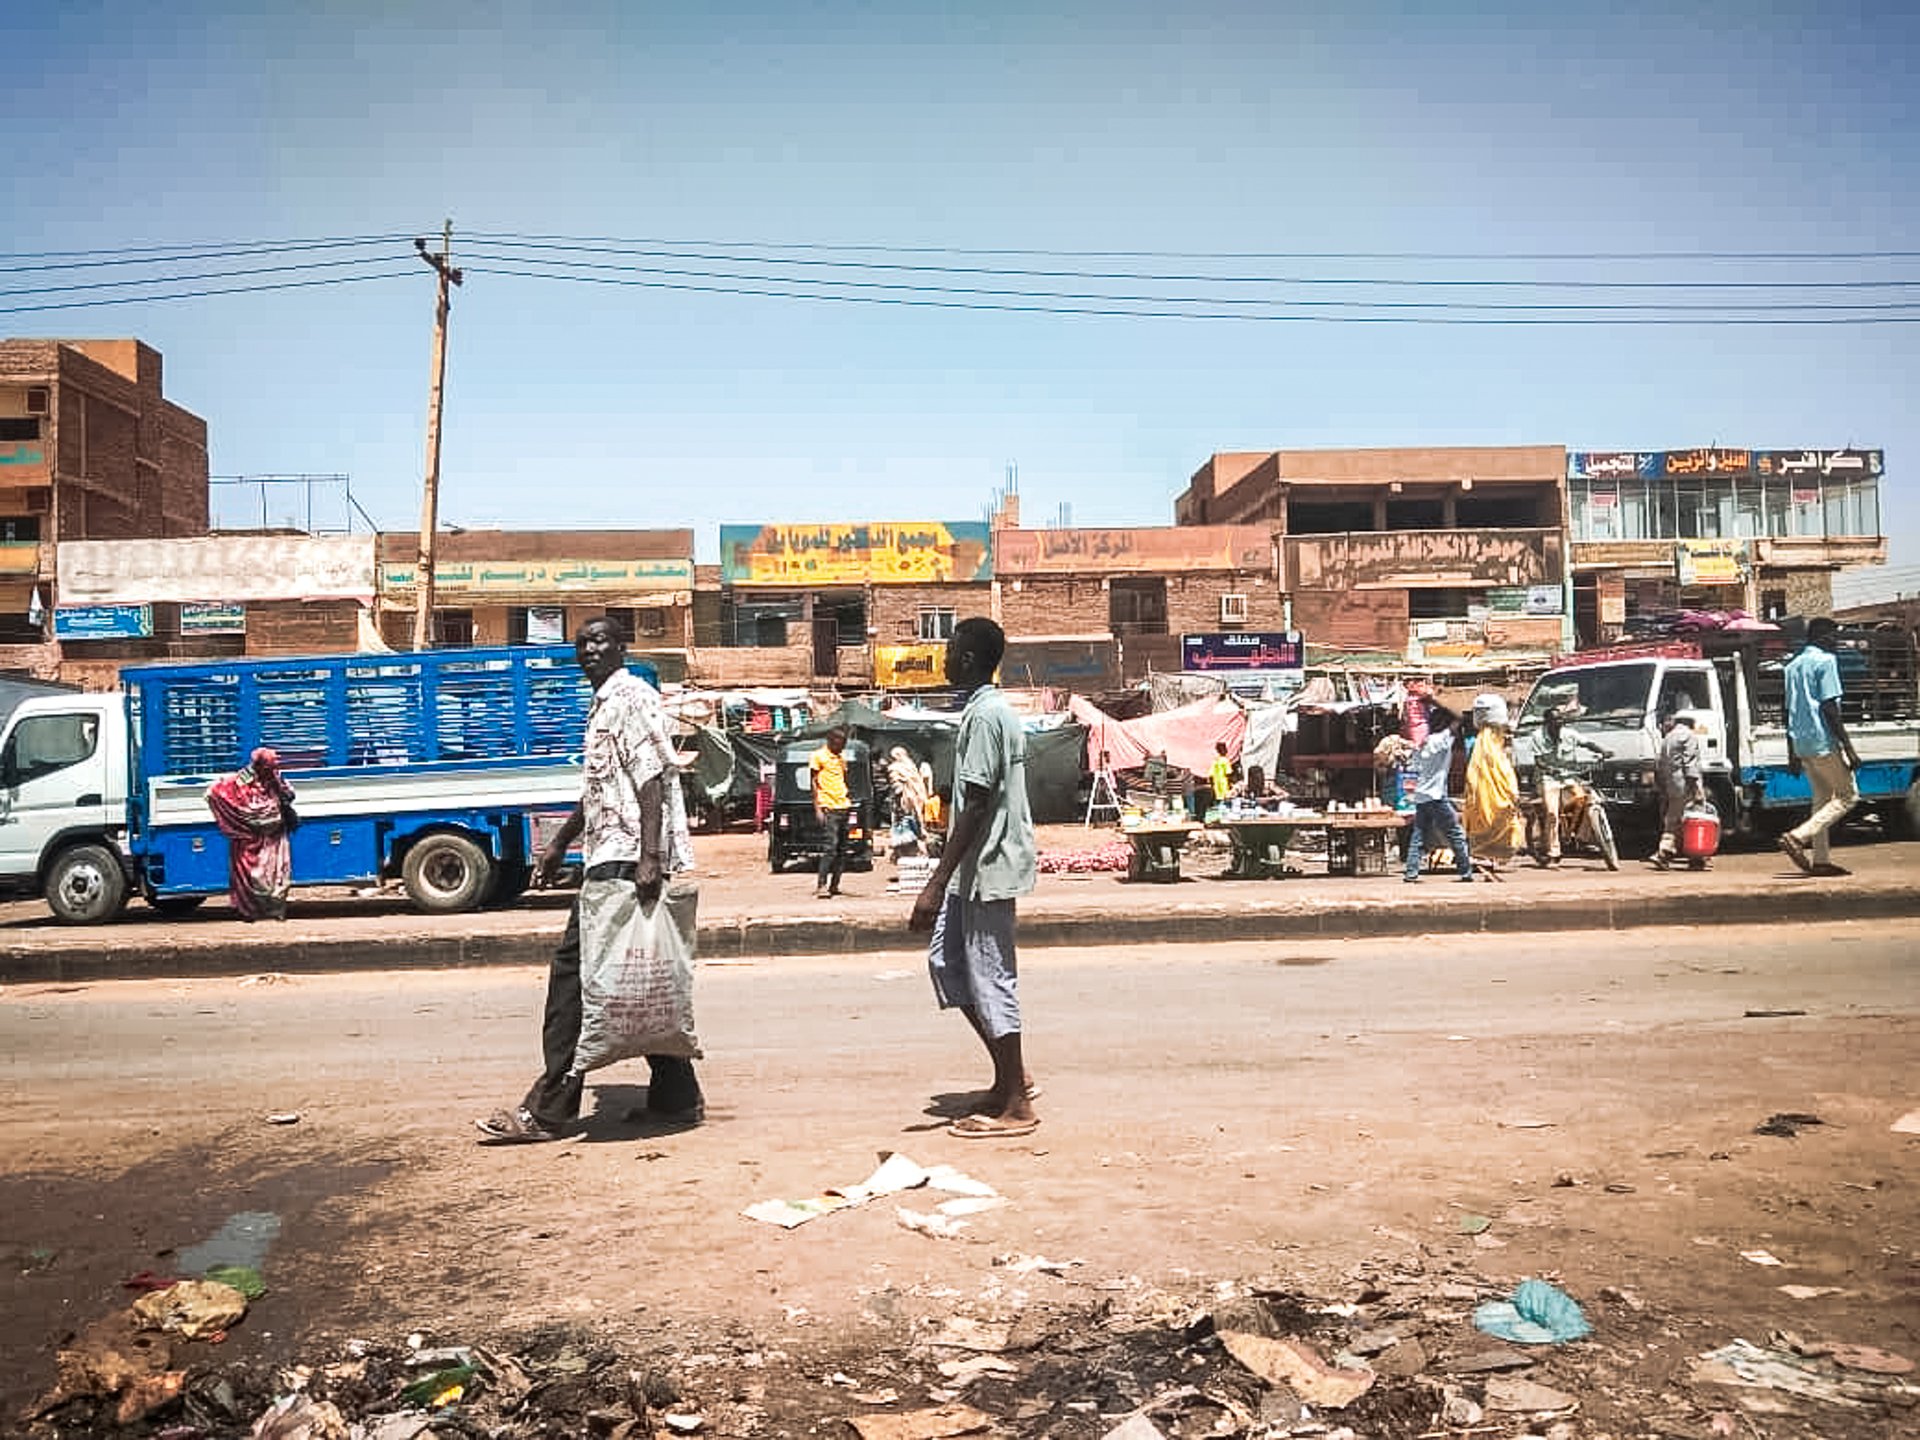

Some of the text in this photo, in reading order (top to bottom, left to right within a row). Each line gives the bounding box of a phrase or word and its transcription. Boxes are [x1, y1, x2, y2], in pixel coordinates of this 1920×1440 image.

[1585, 453, 1635, 478] للتجميل
[1777, 451, 1864, 475] كوافير
[1223, 635, 1260, 646] مغلق
